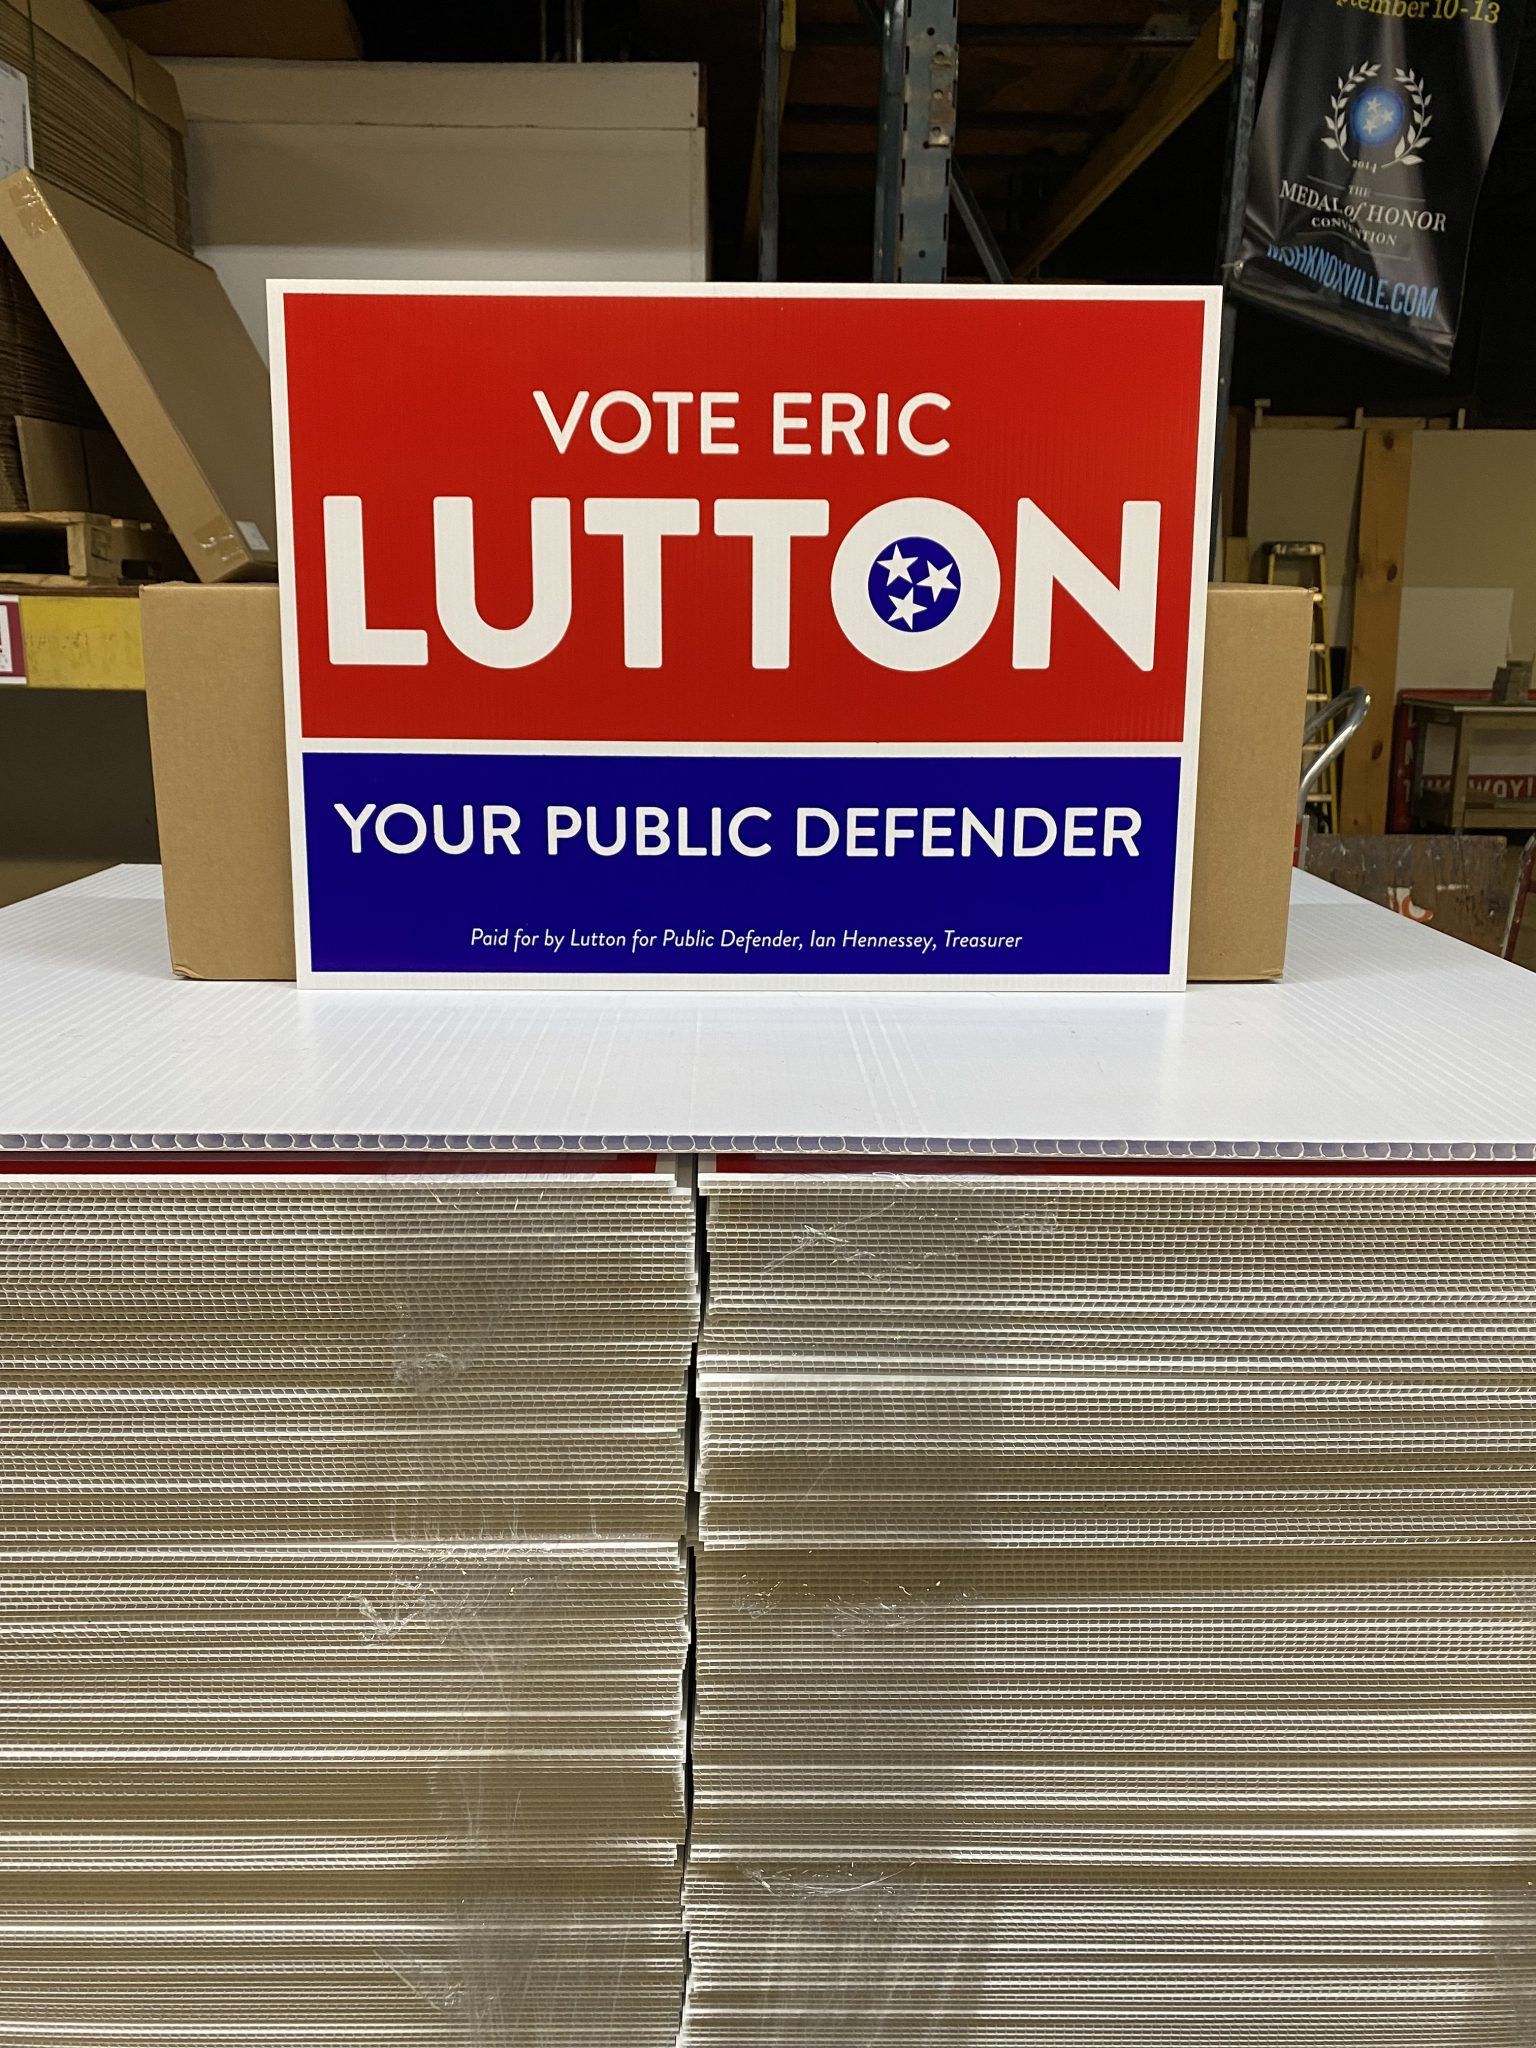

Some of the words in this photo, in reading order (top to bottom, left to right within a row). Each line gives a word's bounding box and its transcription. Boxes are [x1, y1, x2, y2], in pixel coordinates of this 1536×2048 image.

[1336, 0, 1428, 18] ember
[1279, 180, 1347, 213] MEDAL
[1343, 203, 1368, 221] of
[1367, 205, 1447, 232] HONOR
[533, 391, 740, 455] VOTE
[773, 392, 951, 456] ERIC
[322, 495, 1162, 672] LUTTON
[334, 803, 521, 856] YOUR
[547, 805, 772, 857] PUBLIC
[797, 806, 1142, 858] DEFENDER
[471, 927, 509, 946] Paid
[513, 928, 540, 953] for
[544, 928, 565, 953] by
[570, 928, 626, 947] Lutton
[632, 928, 658, 954] for
[662, 928, 715, 947] Public
[720, 929, 803, 954] Defender,
[810, 929, 836, 948] Ian
[842, 929, 937, 955] Hennessey,
[944, 929, 1023, 948] Treasurer
